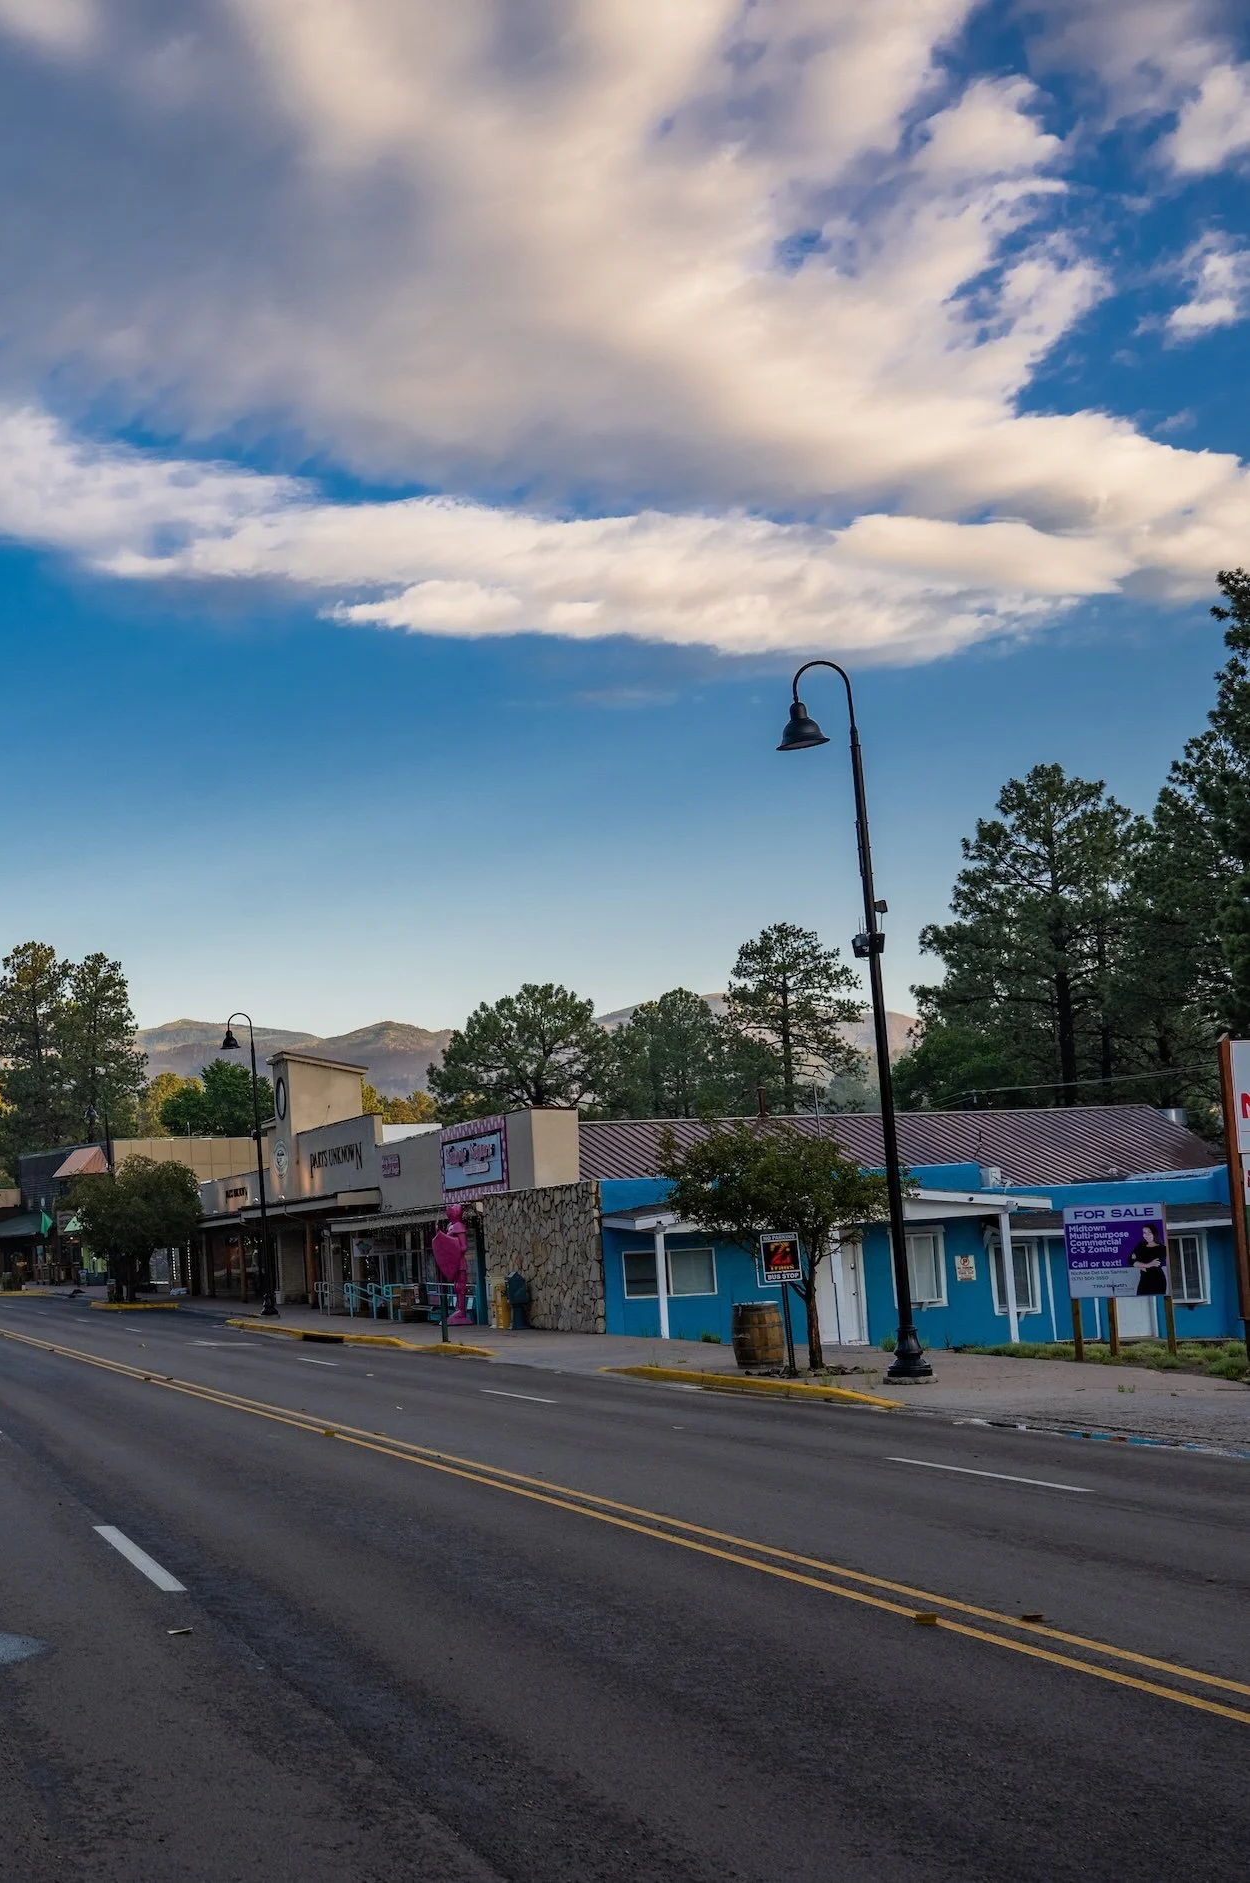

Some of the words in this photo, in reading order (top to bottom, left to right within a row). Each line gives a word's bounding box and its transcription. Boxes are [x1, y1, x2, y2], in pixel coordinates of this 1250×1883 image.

[310, 1150, 327, 1178] PARTS
[328, 1142, 362, 1170] UNKNOWN
[1074, 1211, 1105, 1219] FOR
[1111, 1207, 1154, 1218] SALE
[1069, 1231, 1129, 1240] Multi-purpose
